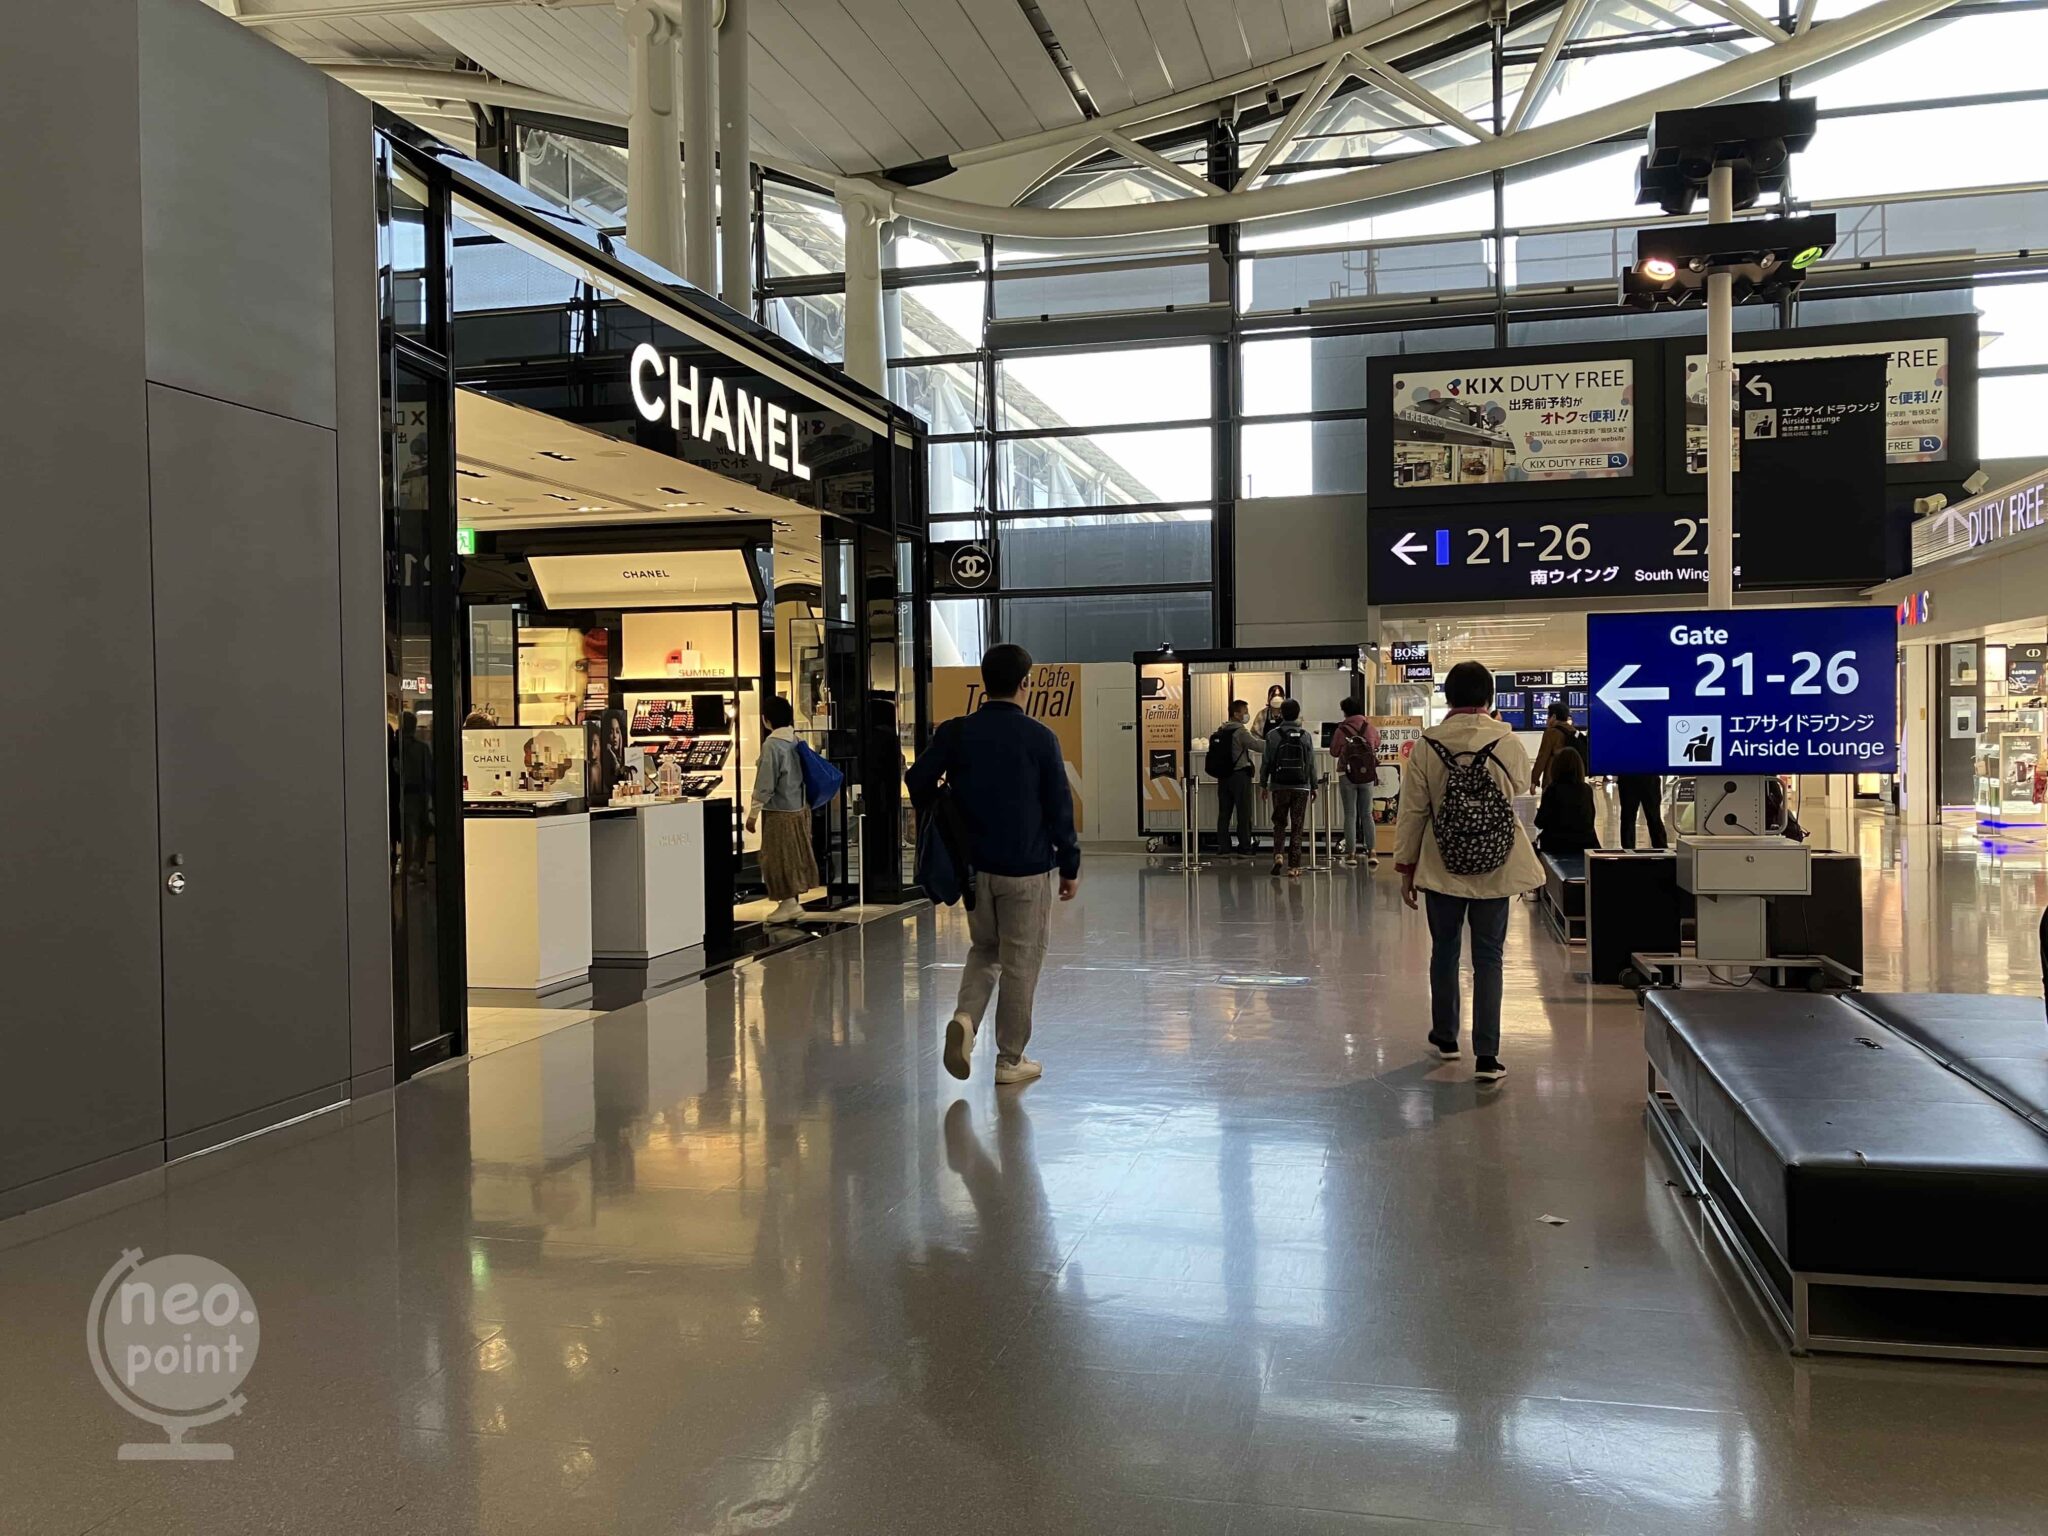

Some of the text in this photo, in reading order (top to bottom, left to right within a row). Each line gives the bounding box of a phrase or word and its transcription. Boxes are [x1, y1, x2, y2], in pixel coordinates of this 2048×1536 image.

[1466, 369, 1625, 395] KIX DUTY FREE
[630, 342, 811, 481] CHANEL
[1781, 401, 1880, 417] エアサイドラウンジ
[1782, 415, 1841, 425] Airside Lounge
[1912, 417, 1939, 425] website
[1570, 437, 1599, 445] pre-order
[1601, 435, 1625, 443] website
[1888, 440, 1913, 451] FREE
[1530, 457, 1603, 469] KIX DUTY FREE
[1969, 484, 2045, 548] DUTY FREE
[1466, 523, 1592, 565] 21-26
[623, 569, 670, 579] CHANEL
[1530, 565, 1620, 586] 南ウイング
[1635, 568, 1674, 582] South
[1670, 625, 1729, 645] Gate
[1394, 647, 1426, 658] BOSS
[678, 668, 726, 677] SUMMER
[1407, 667, 1431, 676] MCM
[1694, 650, 1860, 697] 21-26
[966, 681, 1075, 717] Teinal
[1145, 708, 1180, 720] Terminal
[1729, 714, 1875, 733] エアサイドラウンジ
[1380, 729, 1420, 740] ENTO
[1729, 739, 1885, 759] Airside Lounge
[473, 755, 512, 763] CHANEL
